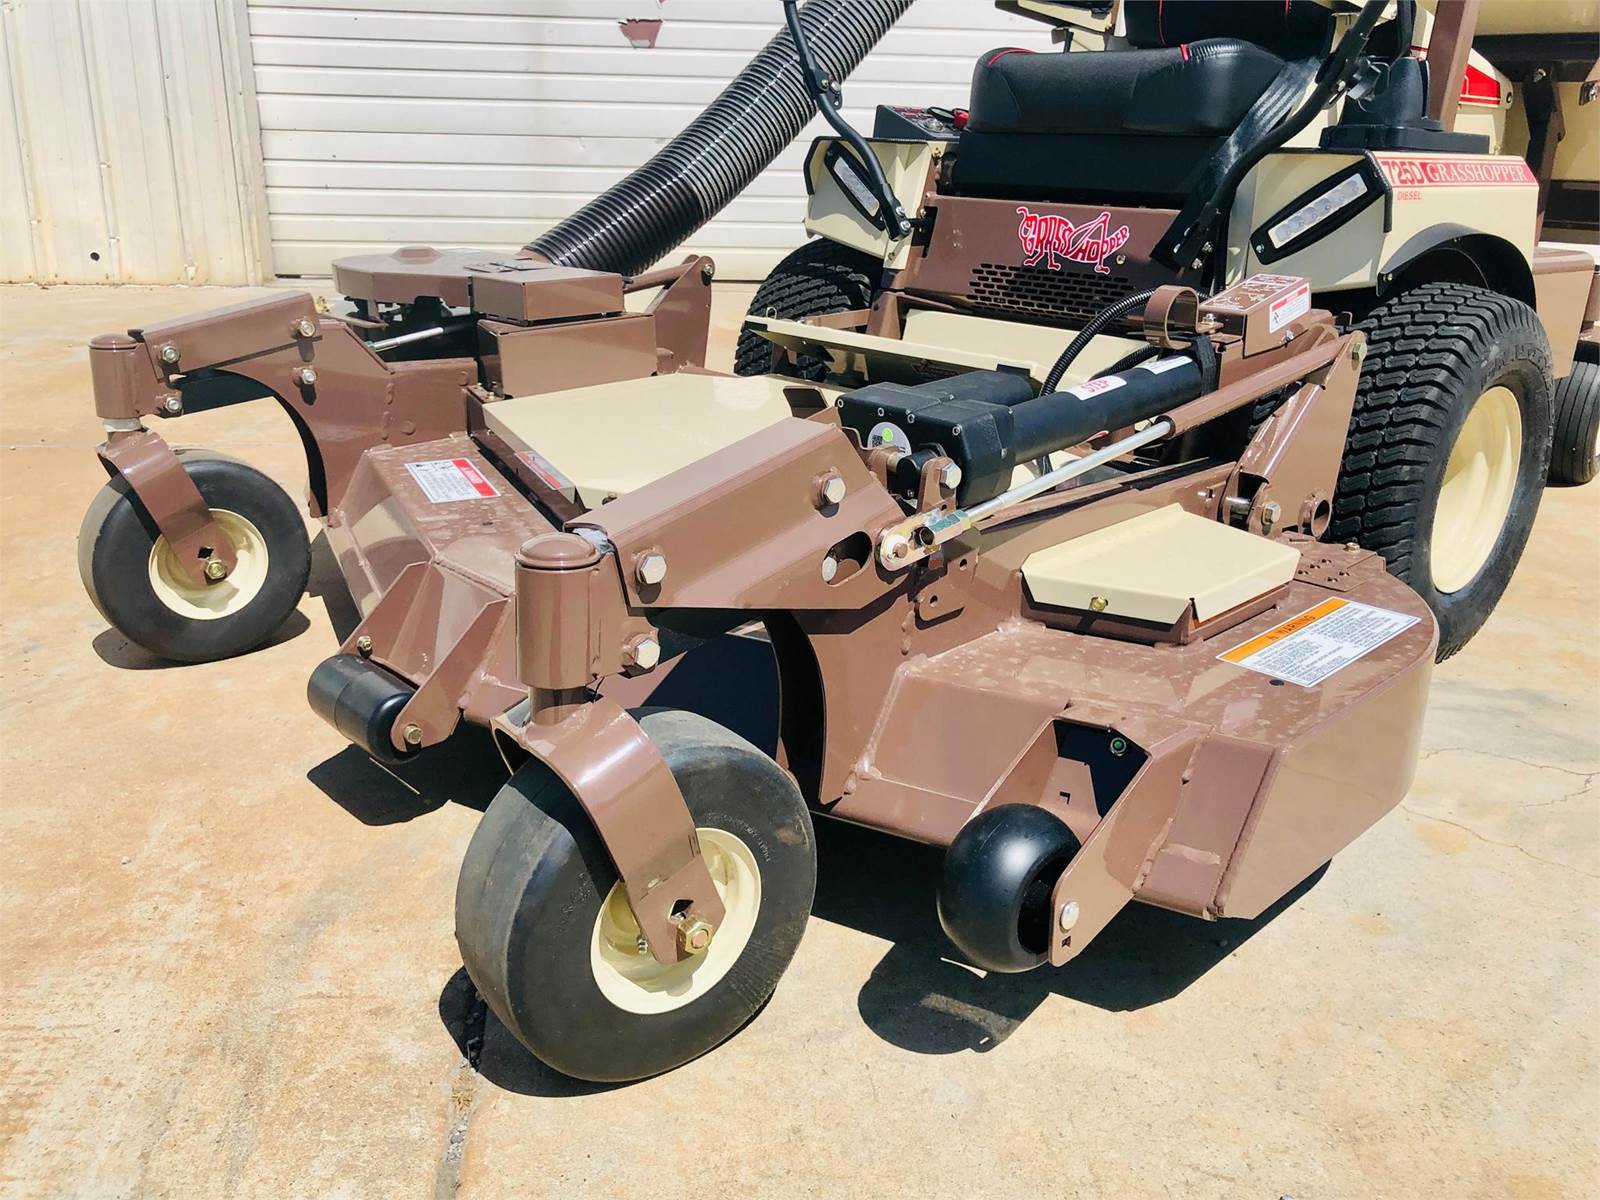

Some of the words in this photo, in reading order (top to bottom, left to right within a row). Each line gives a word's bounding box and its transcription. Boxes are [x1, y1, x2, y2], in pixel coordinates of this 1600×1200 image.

[1426, 162, 1527, 183] GRASSHOPPER
[1397, 191, 1422, 201] DIESEL
[1018, 211, 1129, 265] GRASSHOPPER
